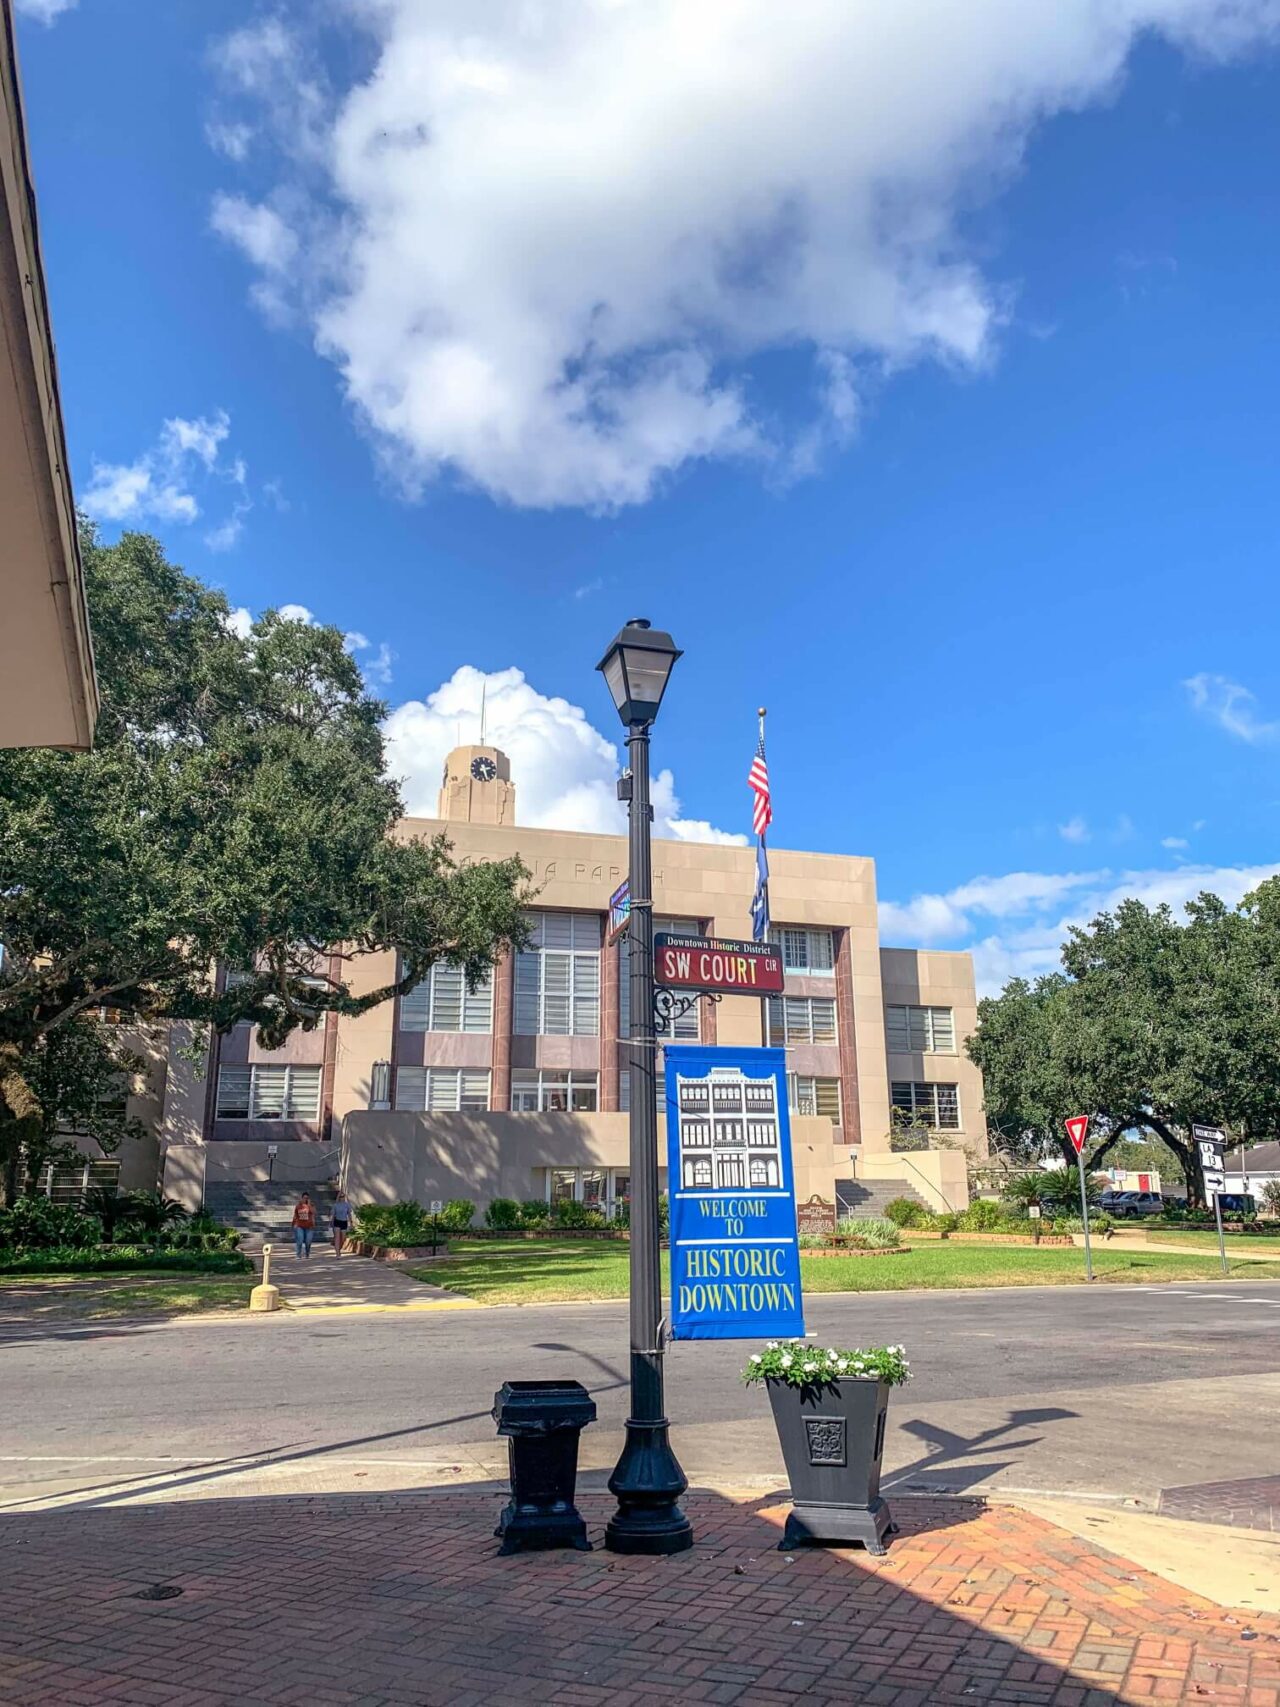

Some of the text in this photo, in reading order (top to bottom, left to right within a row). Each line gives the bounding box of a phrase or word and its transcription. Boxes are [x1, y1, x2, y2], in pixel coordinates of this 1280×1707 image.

[575, 863, 664, 885] PAH
[667, 936, 771, 955] Downtown Historic District
[665, 951, 778, 985] SW COURT CIR
[700, 1199, 768, 1218] WELCOME
[724, 1218, 744, 1237] TO
[686, 1249, 786, 1277] HISTORIC
[679, 1283, 795, 1313] DOWNTOWN
